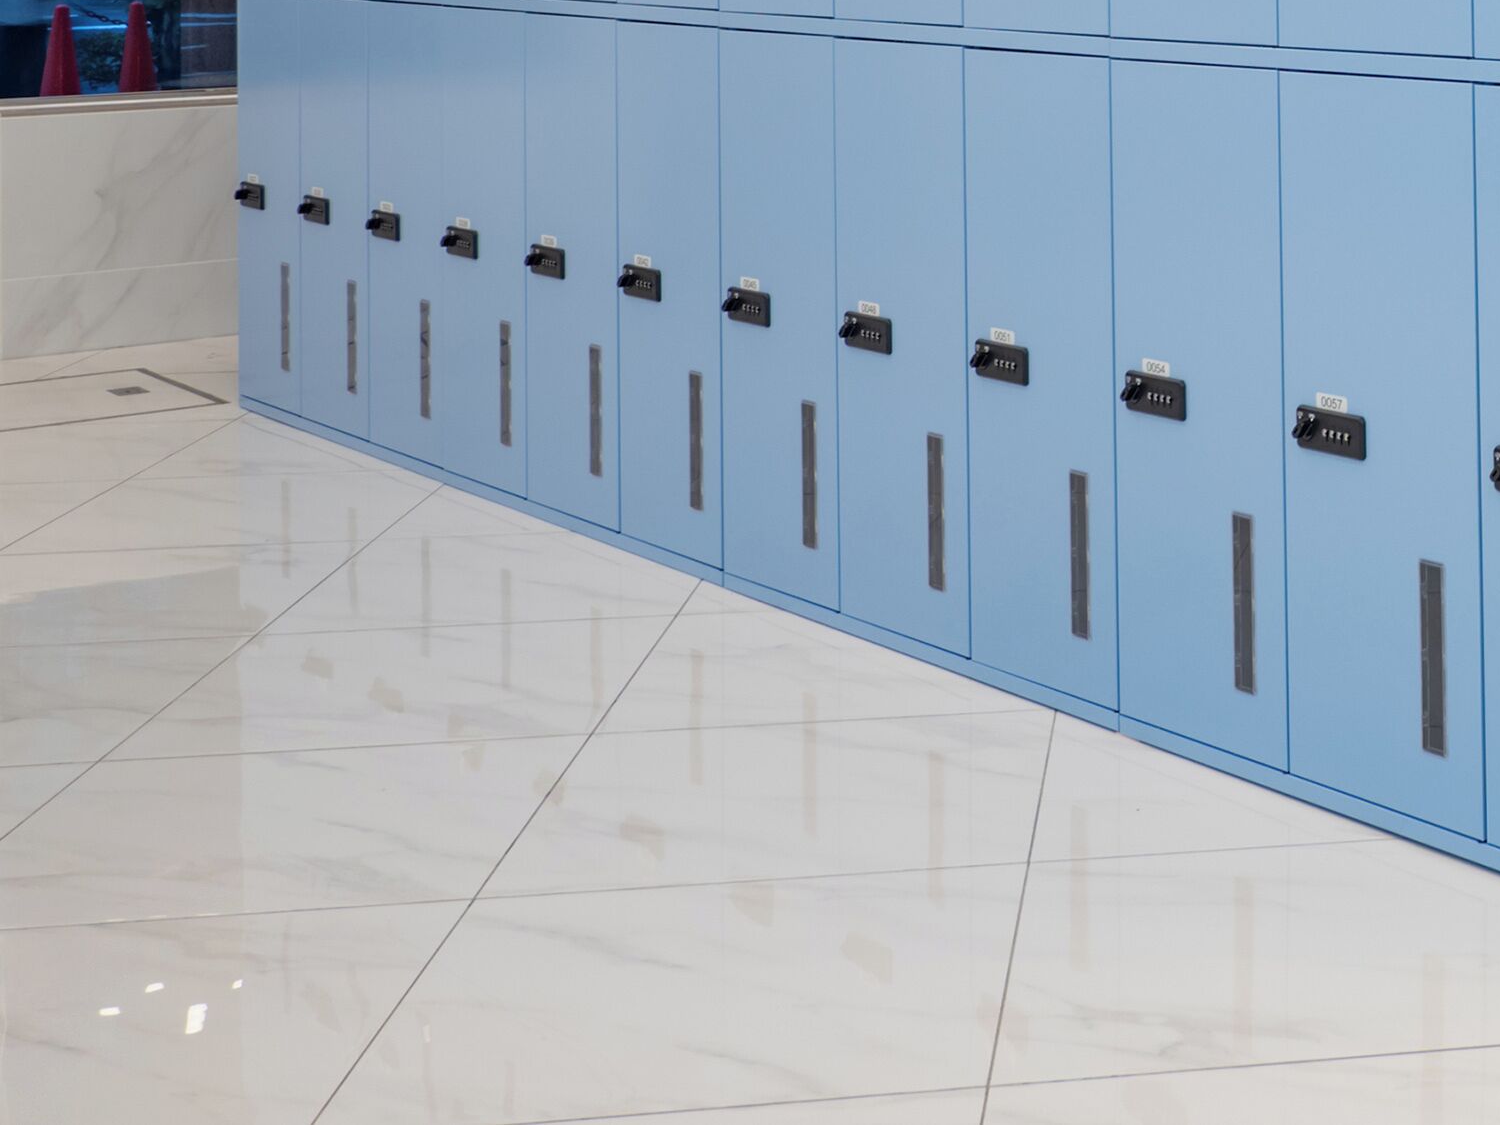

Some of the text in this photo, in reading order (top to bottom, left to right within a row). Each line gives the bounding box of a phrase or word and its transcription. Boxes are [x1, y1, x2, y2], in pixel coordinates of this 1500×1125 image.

[993, 329, 1010, 342] 0051
[1146, 361, 1166, 374] 0054
[1321, 396, 1342, 410] 0057
